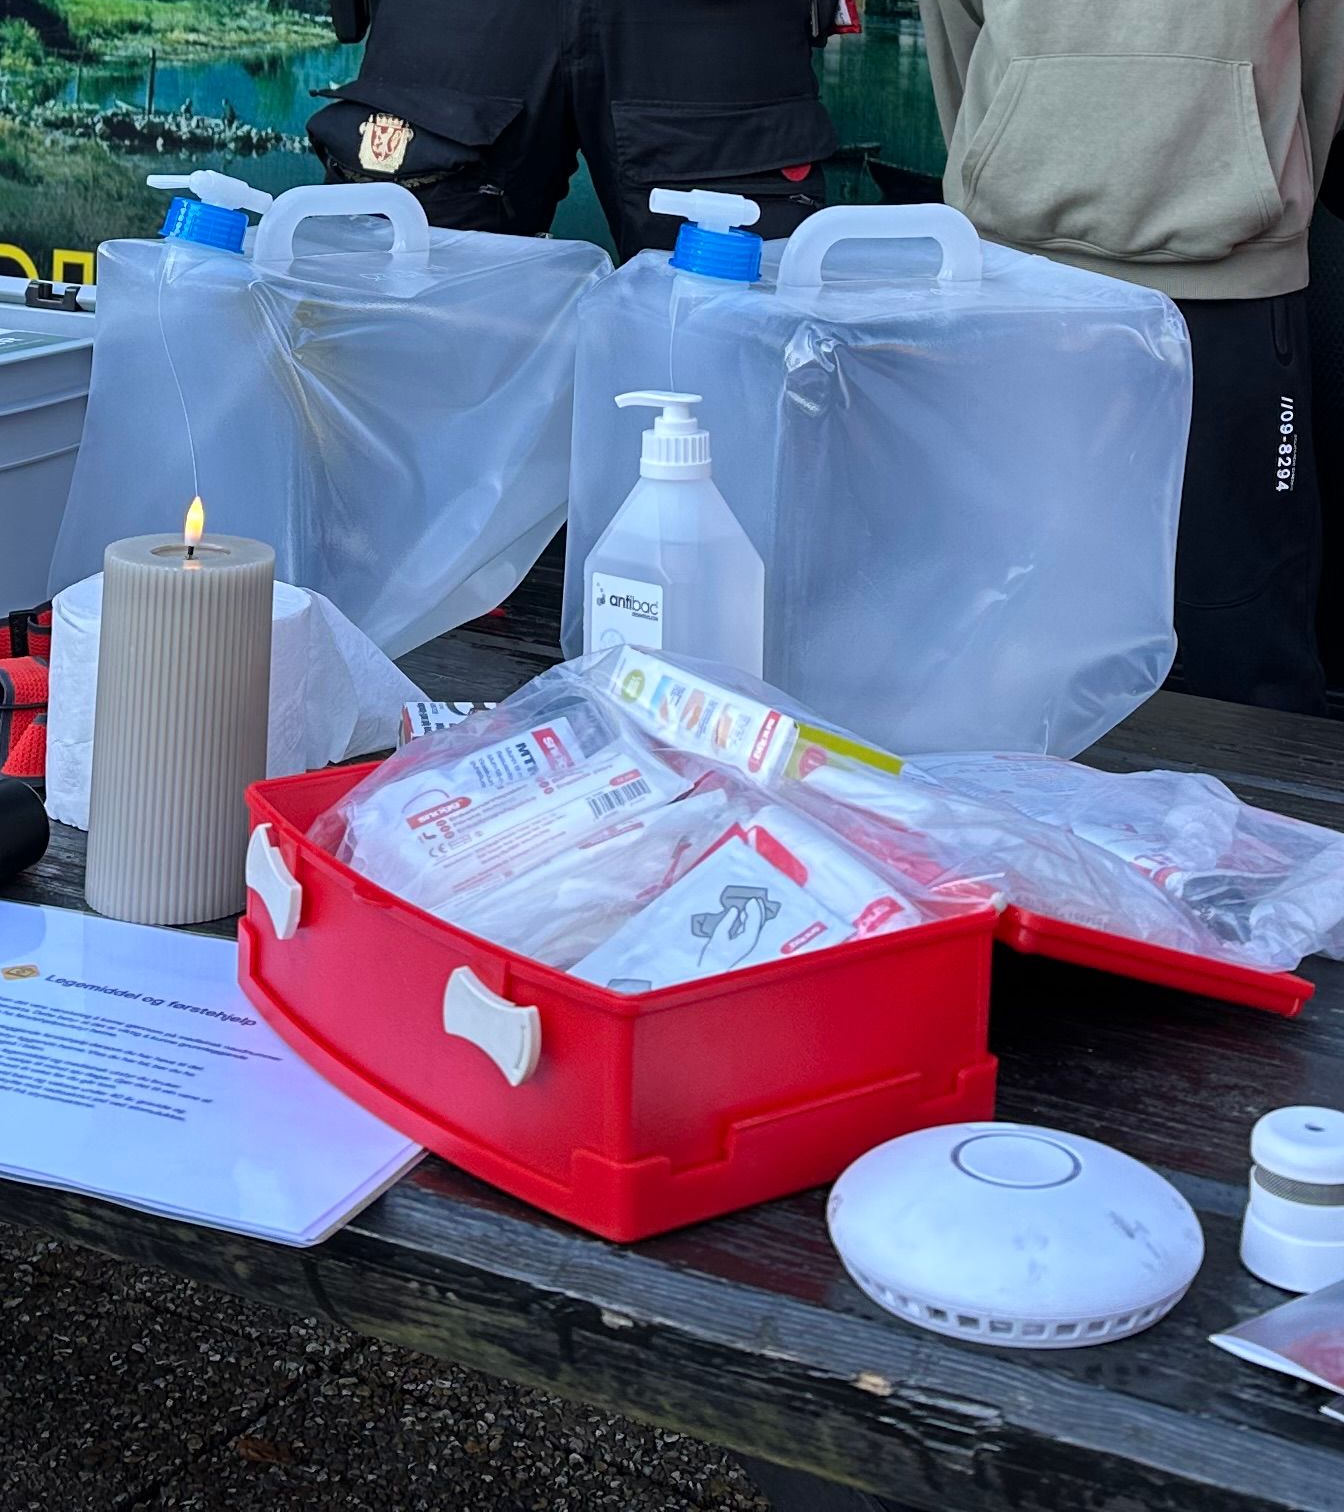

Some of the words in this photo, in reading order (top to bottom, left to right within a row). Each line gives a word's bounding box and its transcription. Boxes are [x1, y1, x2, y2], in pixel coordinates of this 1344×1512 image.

[1275, 396, 1294, 492] //09-8294
[609, 594, 659, 616] antibac
[45, 973, 139, 1003] Legemiddel
[140, 994, 164, 1008] og
[166, 999, 257, 1028] førstehjelp
